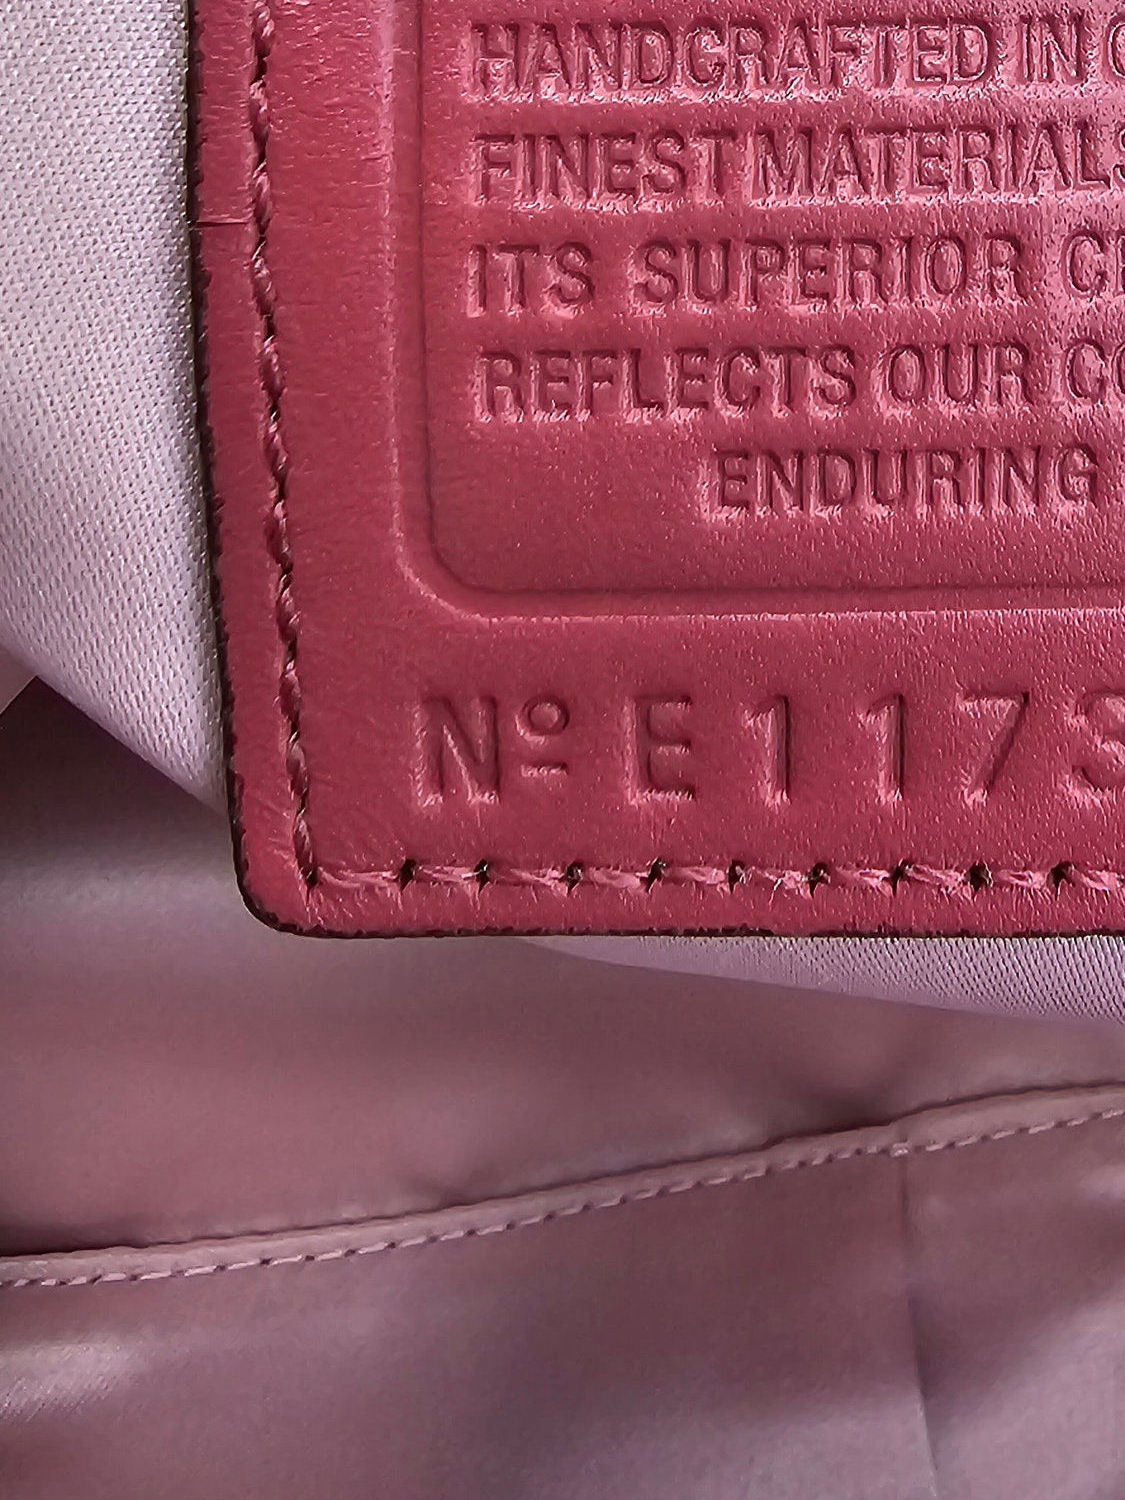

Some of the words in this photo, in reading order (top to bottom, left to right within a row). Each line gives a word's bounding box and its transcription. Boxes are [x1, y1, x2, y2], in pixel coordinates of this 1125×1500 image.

[470, 18, 1000, 97] HANDCRAFTED
[1013, 14, 1092, 88] IN
[470, 126, 736, 206] FINEST
[466, 240, 595, 316] ITS
[626, 230, 1032, 313] SUPERIOR
[474, 340, 858, 422] REFLECTS
[878, 336, 1036, 415] OUR
[702, 445, 1104, 520] ENDURING
